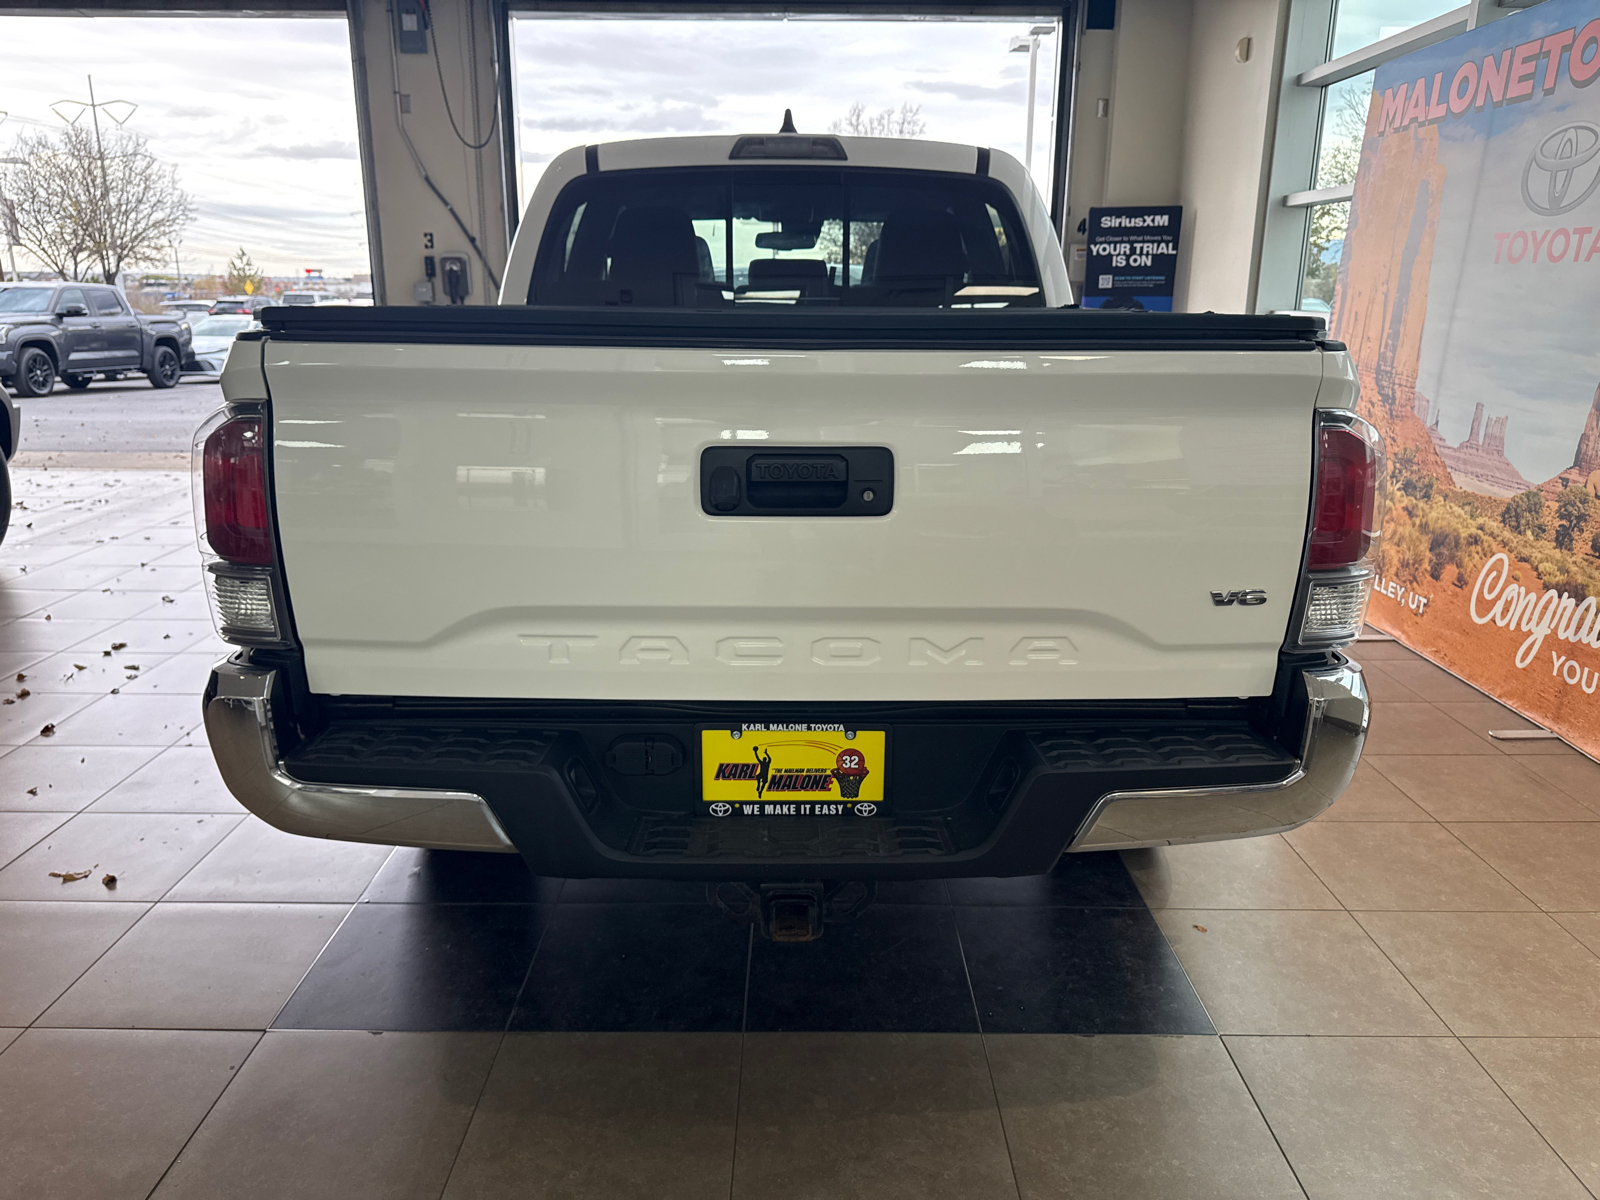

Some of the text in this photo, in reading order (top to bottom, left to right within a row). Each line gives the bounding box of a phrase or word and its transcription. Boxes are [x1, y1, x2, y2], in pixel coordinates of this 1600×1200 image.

[1076, 217, 1087, 235] 4
[1100, 214, 1169, 228] SiriusXM
[423, 232, 434, 249] 3
[1090, 242, 1131, 256] YOUR
[1133, 242, 1177, 255] TRIAL
[1112, 254, 1152, 267] IS ON
[755, 462, 840, 480] TOYOTA
[1209, 589, 1267, 606] V6
[1408, 591, 1428, 614] UT
[517, 633, 1079, 667] TACOMA
[742, 723, 845, 732] KARL MALONE TOYOTA
[842, 755, 859, 769] 32
[714, 763, 760, 781] KARL
[766, 774, 834, 791] MALONE
[743, 804, 844, 815] WE MAKE IT EASY
